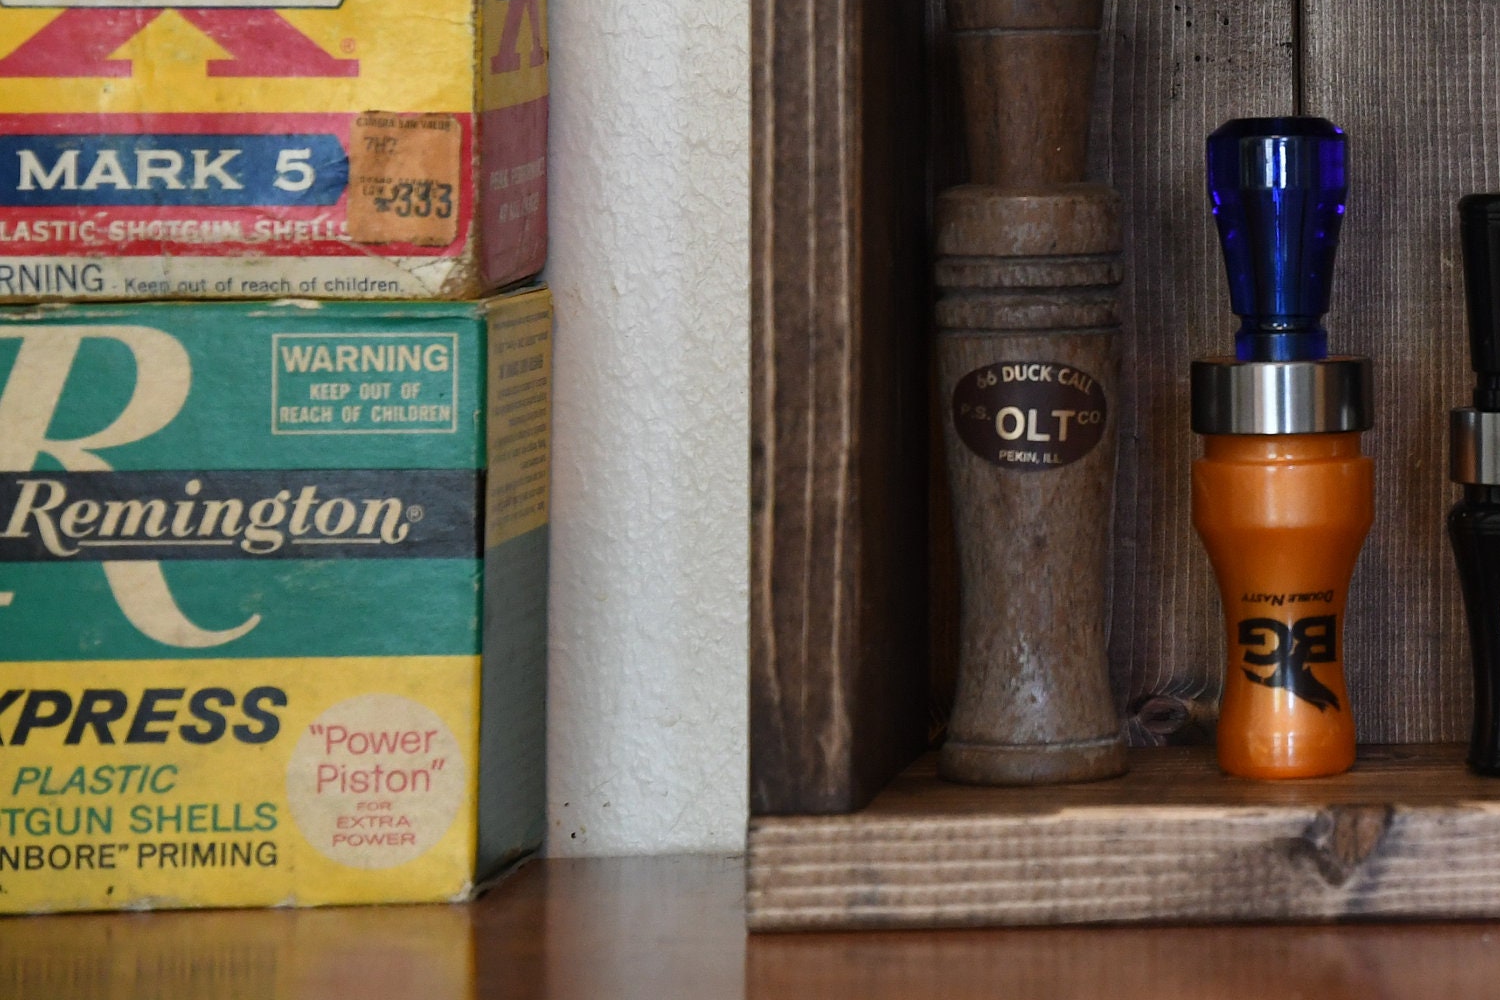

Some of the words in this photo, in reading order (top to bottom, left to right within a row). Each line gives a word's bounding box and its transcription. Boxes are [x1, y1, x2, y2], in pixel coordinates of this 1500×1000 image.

[17, 148, 244, 191] MARK
[274, 148, 316, 192] 5
[108, 219, 243, 243] SHOTGUN
[124, 278, 170, 295] Keep
[177, 279, 207, 293] out
[215, 277, 233, 293] of
[241, 278, 290, 293] reach
[299, 277, 318, 293] of
[281, 344, 450, 373] WARNING
[310, 382, 351, 400] KEEP
[360, 382, 392, 400] OUT
[401, 382, 422, 399] OF
[1002, 363, 1053, 383] DUCK
[1058, 368, 1093, 396] CALL
[279, 405, 334, 424] REACH
[341, 405, 362, 423] OF
[370, 404, 450, 423] CHILDREN
[995, 406, 1076, 442] OLT
[2, 478, 410, 558] Remington
[309, 724, 439, 756] "Power
[12, 763, 179, 796] PLASTIC
[316, 758, 446, 793] Piston"
[0, 806, 113, 838] TGUN
[129, 802, 279, 834] SHELLS
[356, 801, 392, 812] FOR
[336, 815, 411, 830] EXTRA
[332, 833, 416, 848] POWER
[137, 842, 279, 869] PRIMING
